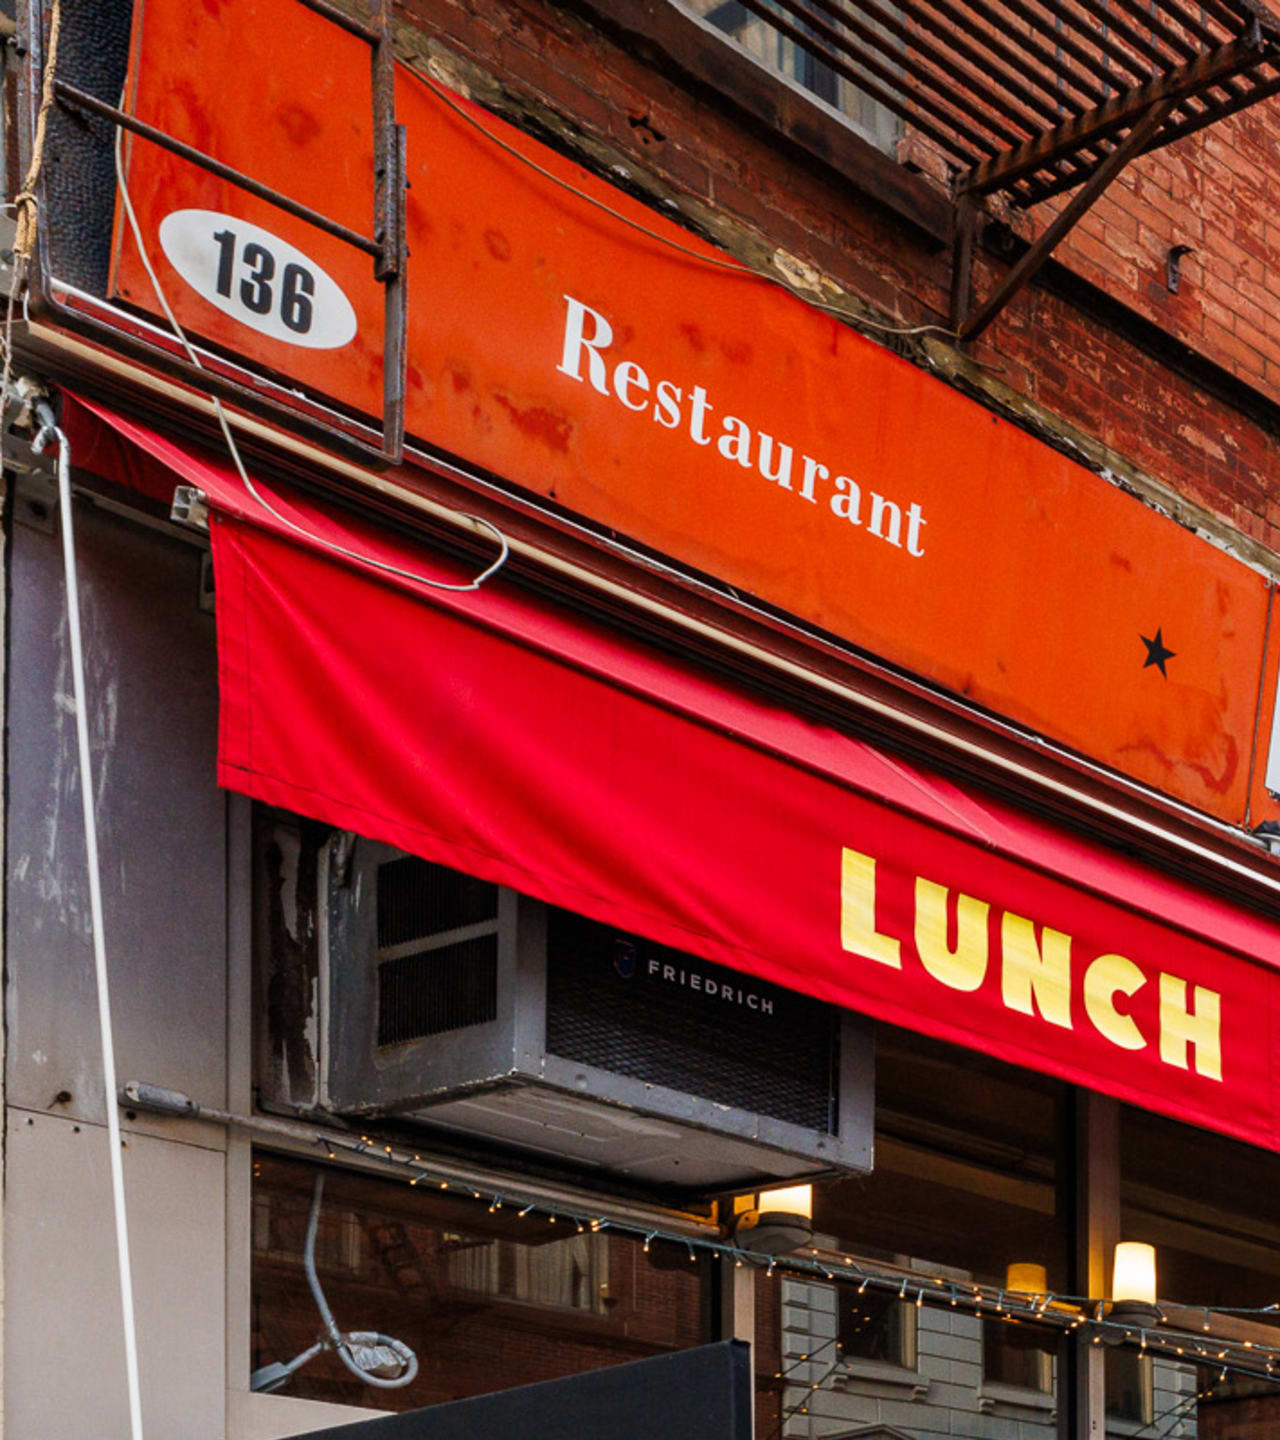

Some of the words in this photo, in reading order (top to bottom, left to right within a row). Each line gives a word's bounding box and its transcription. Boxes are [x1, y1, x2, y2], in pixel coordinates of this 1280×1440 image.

[212, 229, 315, 335] 136
[556, 294, 928, 558] Restaurant
[648, 960, 774, 1014] FRIEDRICH
[840, 847, 1223, 1082] LUNCH
